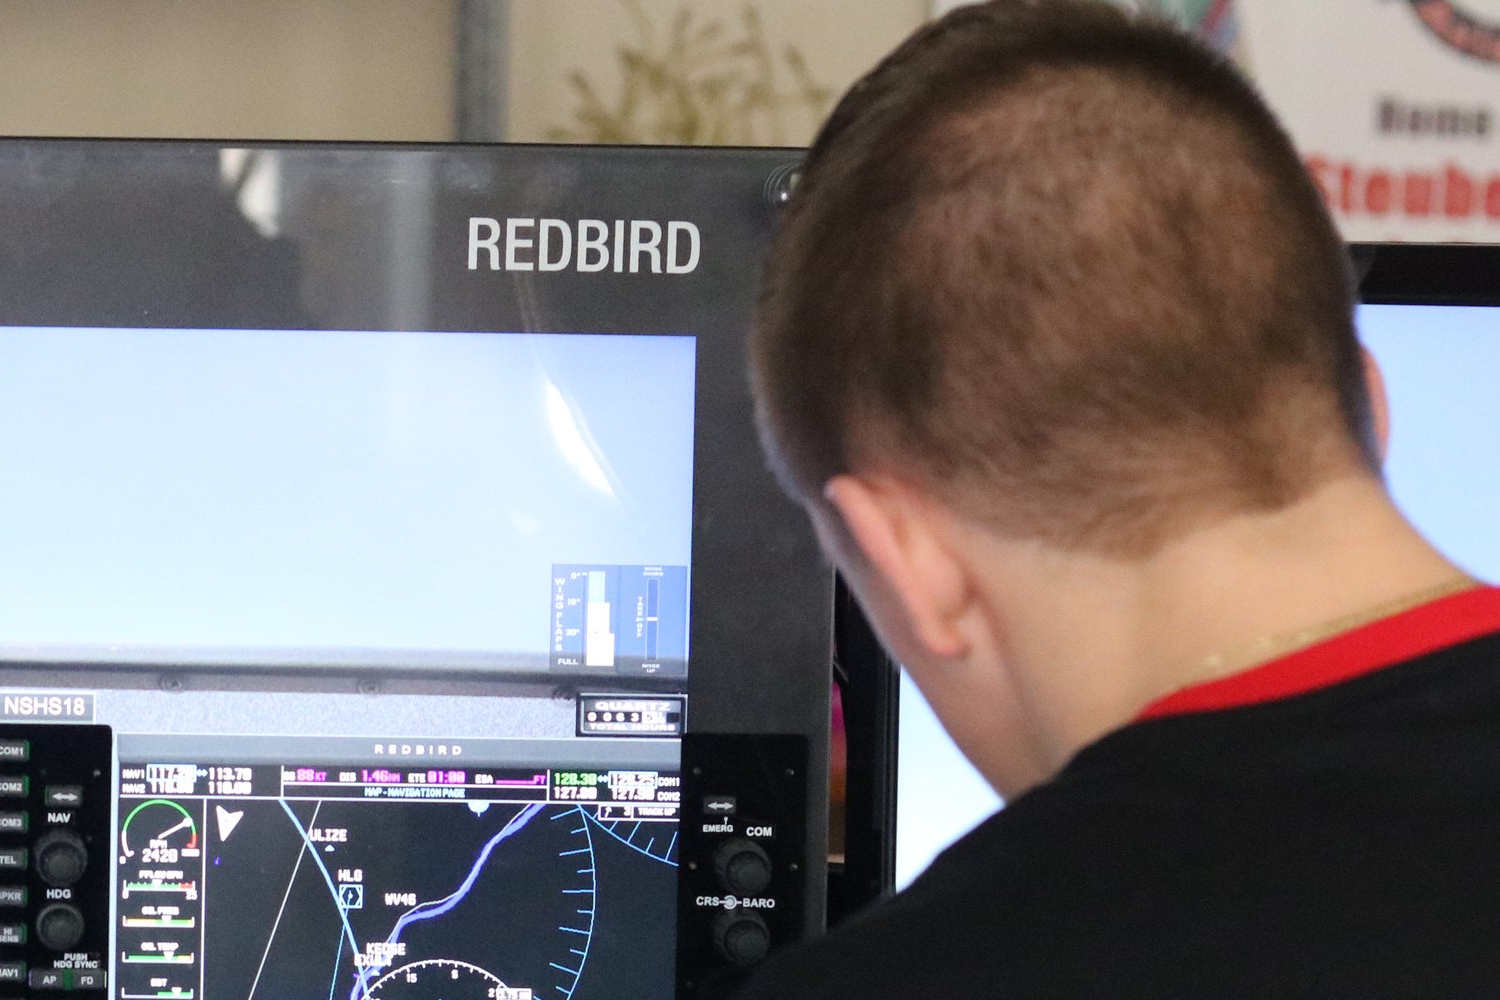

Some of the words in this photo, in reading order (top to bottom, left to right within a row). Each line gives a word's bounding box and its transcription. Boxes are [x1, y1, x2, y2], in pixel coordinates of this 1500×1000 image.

[468, 217, 700, 274] REDBIRD
[4, 696, 85, 716] NSHS18
[595, 701, 670, 711] QUARTZ
[374, 744, 462, 756] REDBIRD
[48, 812, 71, 823] NAV
[702, 824, 733, 833] EMERG
[746, 827, 772, 837] COM
[309, 829, 347, 842] ULIZE
[46, 889, 71, 899] HDG
[696, 896, 720, 907] CRS
[743, 898, 775, 909] BARO
[64, 953, 88, 961] PUSH
[54, 961, 72, 969] HDG
[74, 961, 98, 969] SYNC
[43, 976, 57, 985] AP
[81, 976, 93, 985] FD
